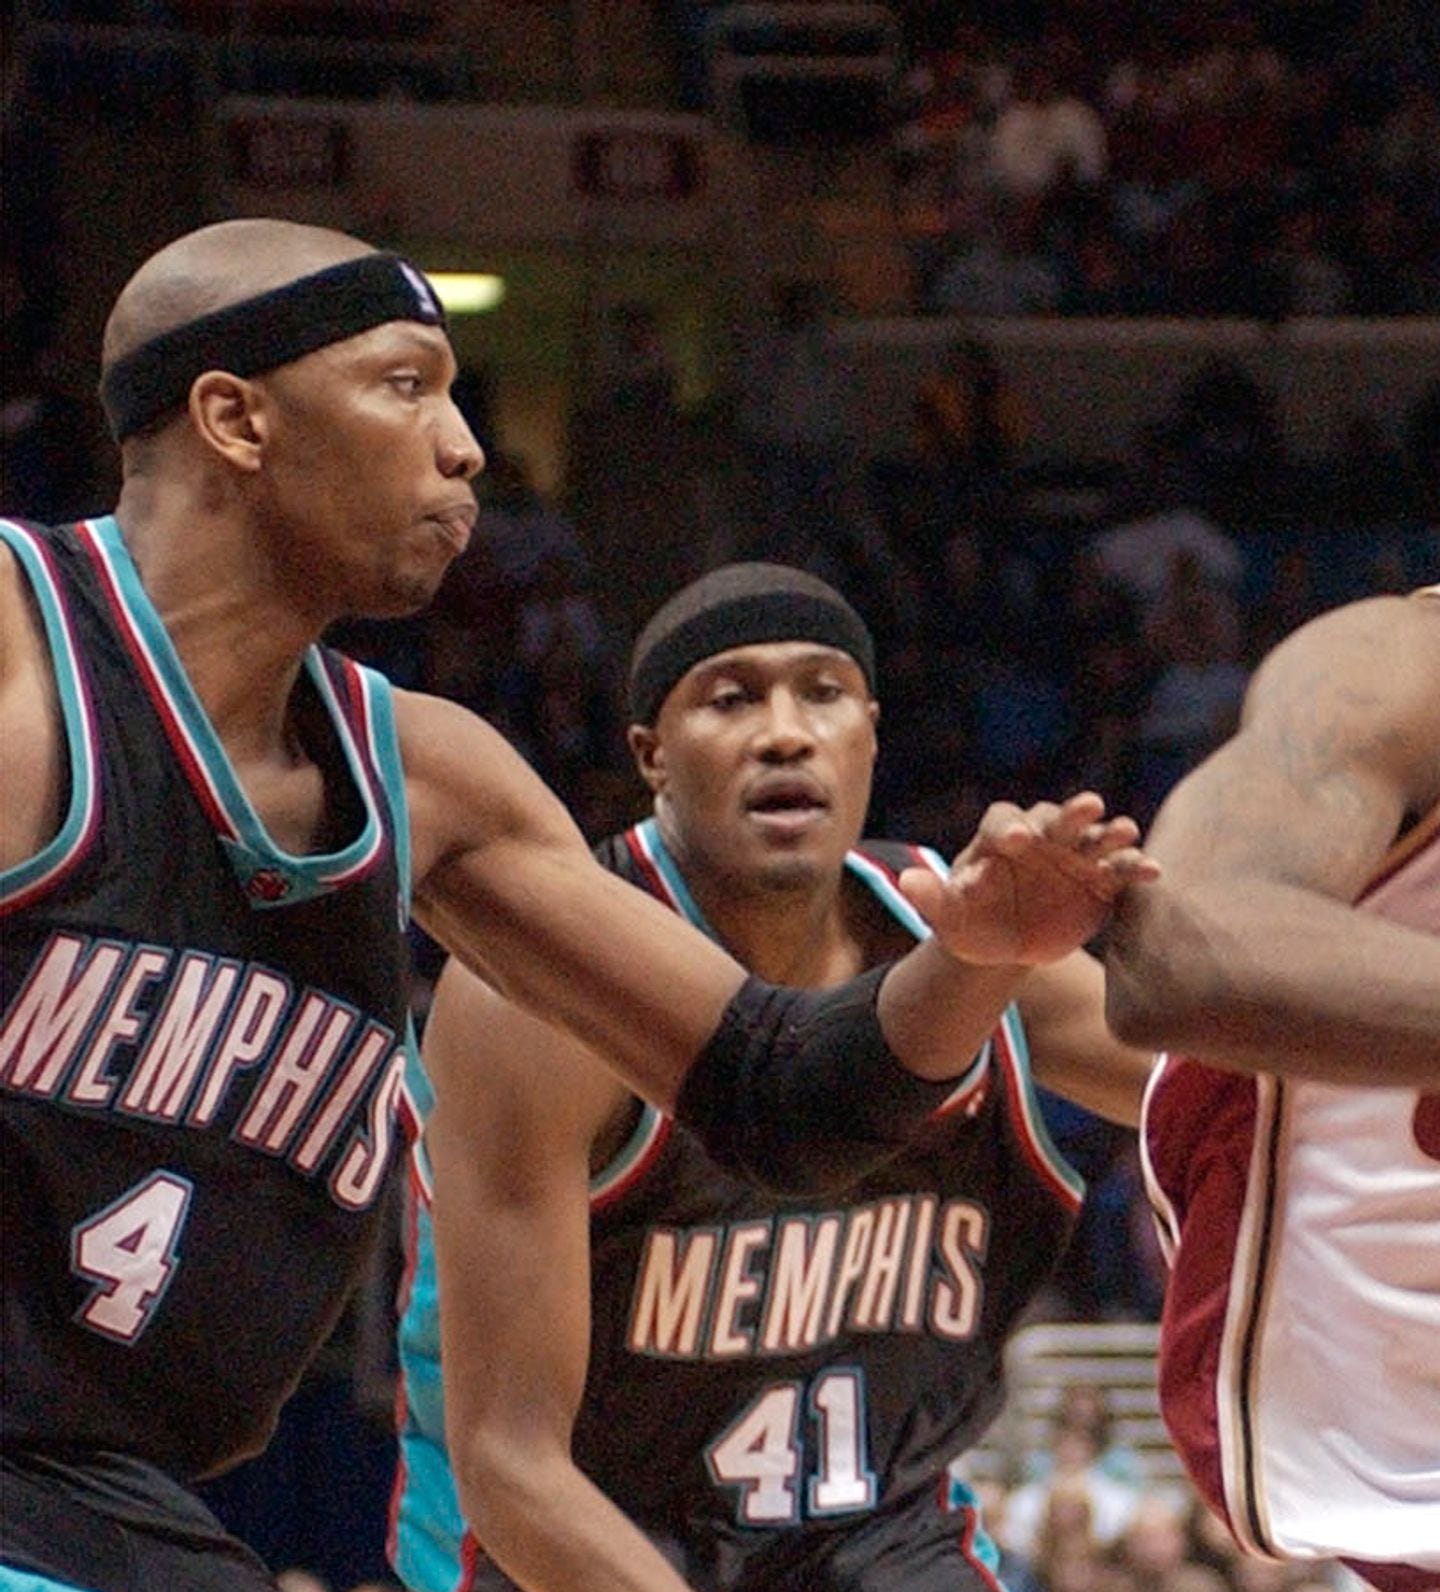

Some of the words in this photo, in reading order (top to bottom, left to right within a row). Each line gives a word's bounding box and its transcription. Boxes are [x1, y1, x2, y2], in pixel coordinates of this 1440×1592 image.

[0, 930, 405, 1211] MEMPHIS
[70, 1167, 195, 1347] 4
[627, 1194, 991, 1360] MEMPHIS
[704, 1366, 878, 1528] 41
